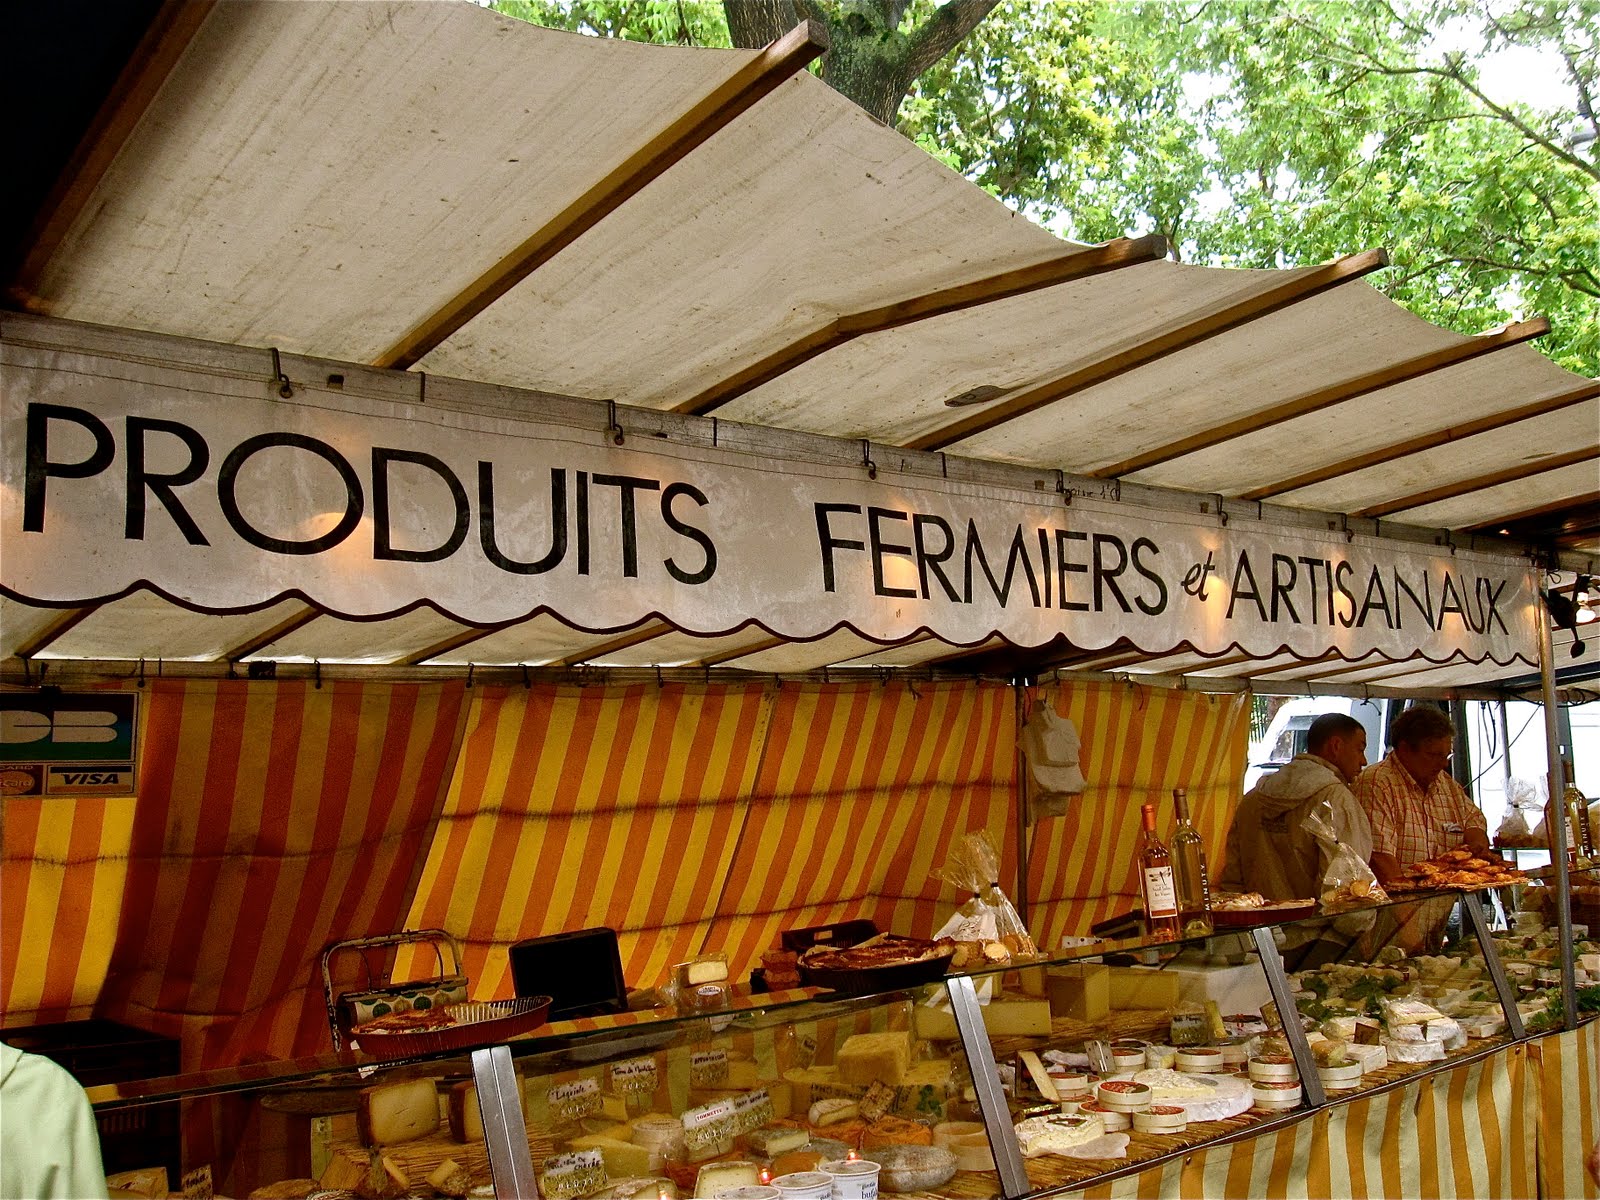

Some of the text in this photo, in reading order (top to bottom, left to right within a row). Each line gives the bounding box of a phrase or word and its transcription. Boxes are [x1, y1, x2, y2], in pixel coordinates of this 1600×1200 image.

[23, 402, 1509, 635] PRODUITS FERMIERS et ARTISANAUX
[62, 774, 119, 785] VISA
[696, 1108, 723, 1120] TOMMETTE
